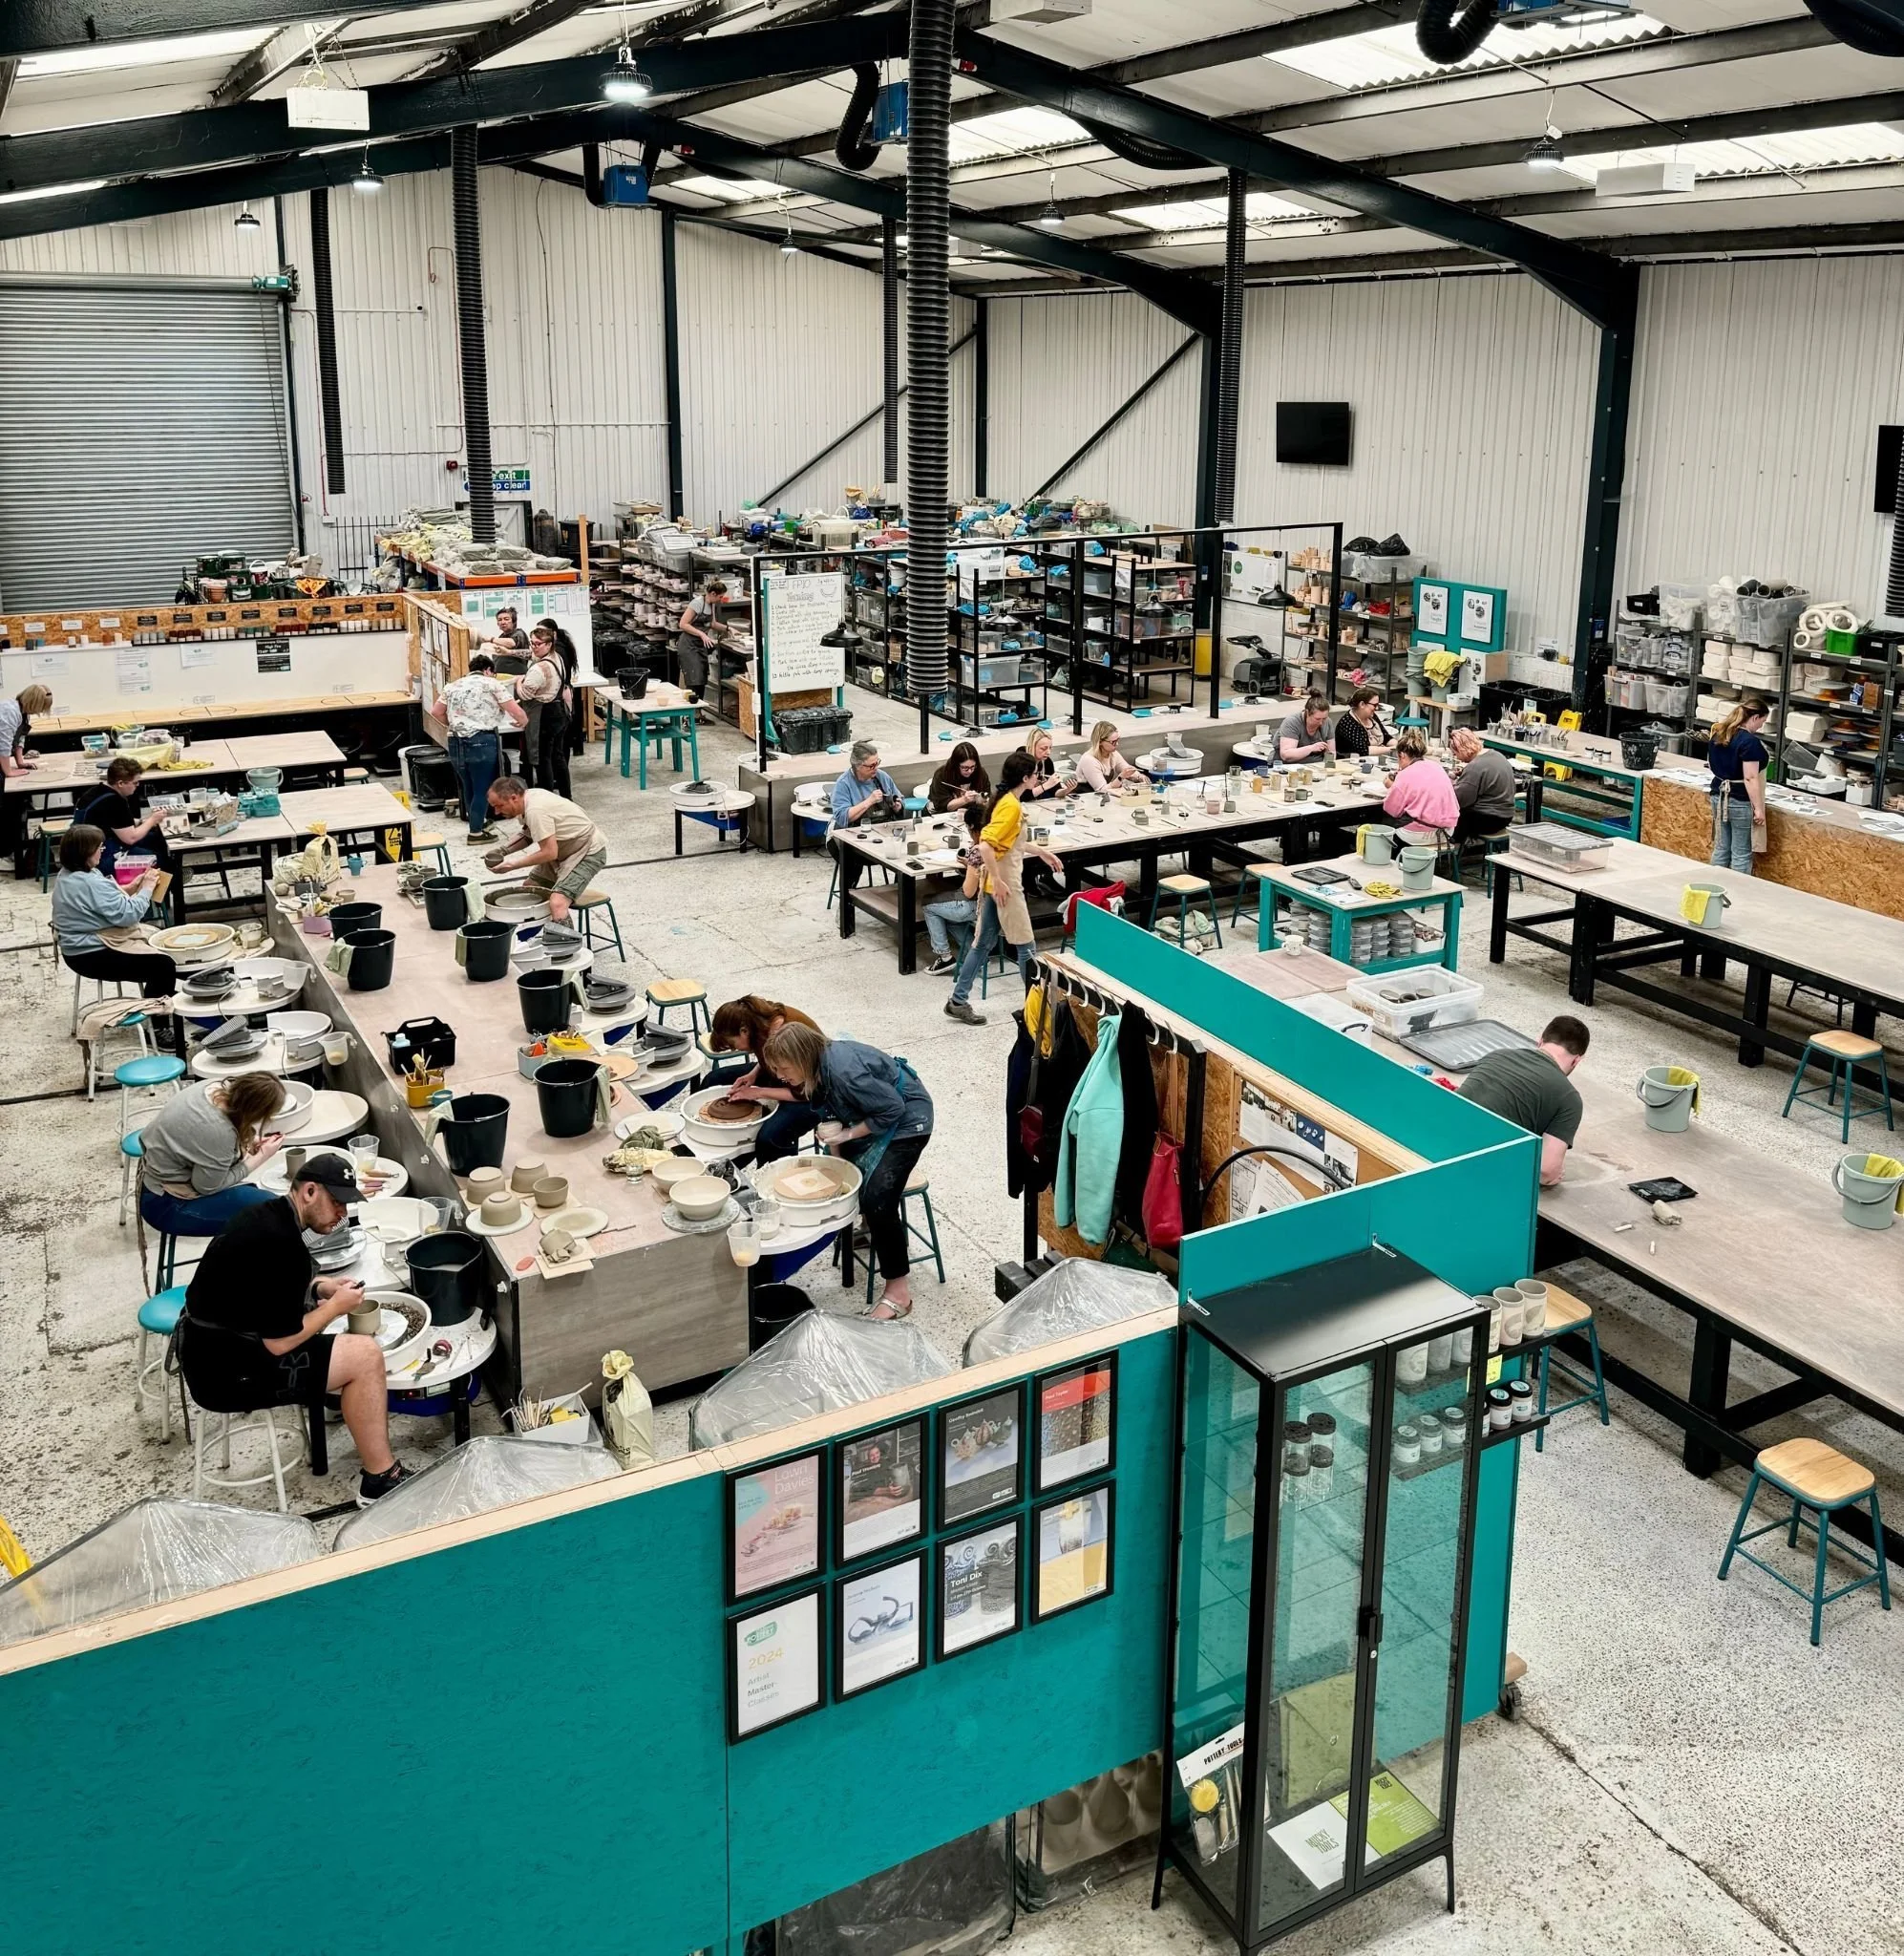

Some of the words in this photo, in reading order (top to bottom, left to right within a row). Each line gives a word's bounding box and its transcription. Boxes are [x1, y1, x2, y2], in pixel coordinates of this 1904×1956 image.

[774, 1474, 815, 1495] Davies
[950, 1574, 968, 1587] Toni
[969, 1571, 983, 1581] Dix
[749, 1647, 784, 1669] 2024
[748, 1672, 771, 1686] Artist
[748, 1691, 780, 1708] Classes
[1203, 1747, 1225, 1765] POTTERY
[1226, 1737, 1242, 1751] TOOLS
[1304, 1828, 1331, 1848] MUCKY
[1315, 1838, 1340, 1855] TOOLS
